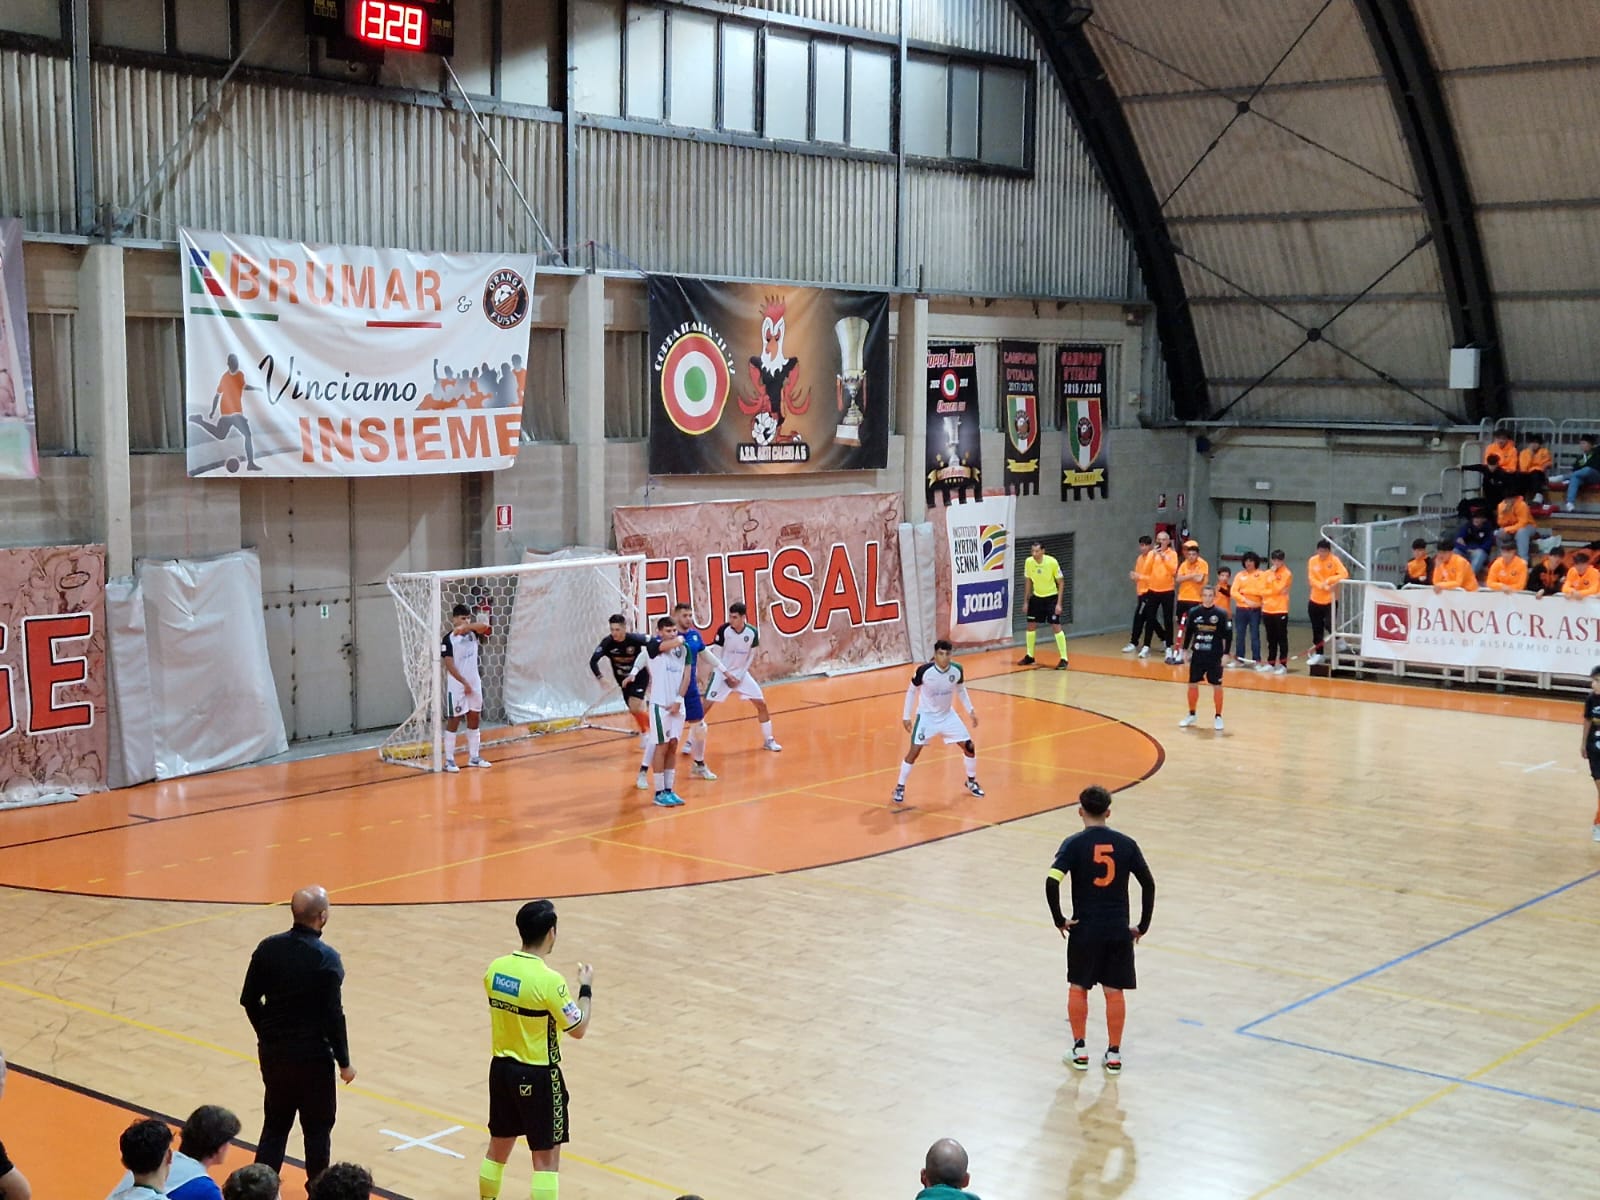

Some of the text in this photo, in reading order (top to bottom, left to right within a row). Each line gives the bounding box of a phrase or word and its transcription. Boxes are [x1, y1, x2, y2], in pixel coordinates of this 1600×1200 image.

[230, 252, 472, 313] BRUMAR &
[654, 329, 681, 371] COPPA
[258, 355, 417, 405] Vinciamo
[298, 413, 522, 463] INSIEME
[954, 537, 978, 555] AYRTON
[956, 555, 980, 574] SENNA
[632, 541, 900, 646] FUTSAL
[1417, 607, 1500, 634] BANCA
[1506, 611, 1553, 639] C.R.
[1093, 844, 1116, 887] 5
